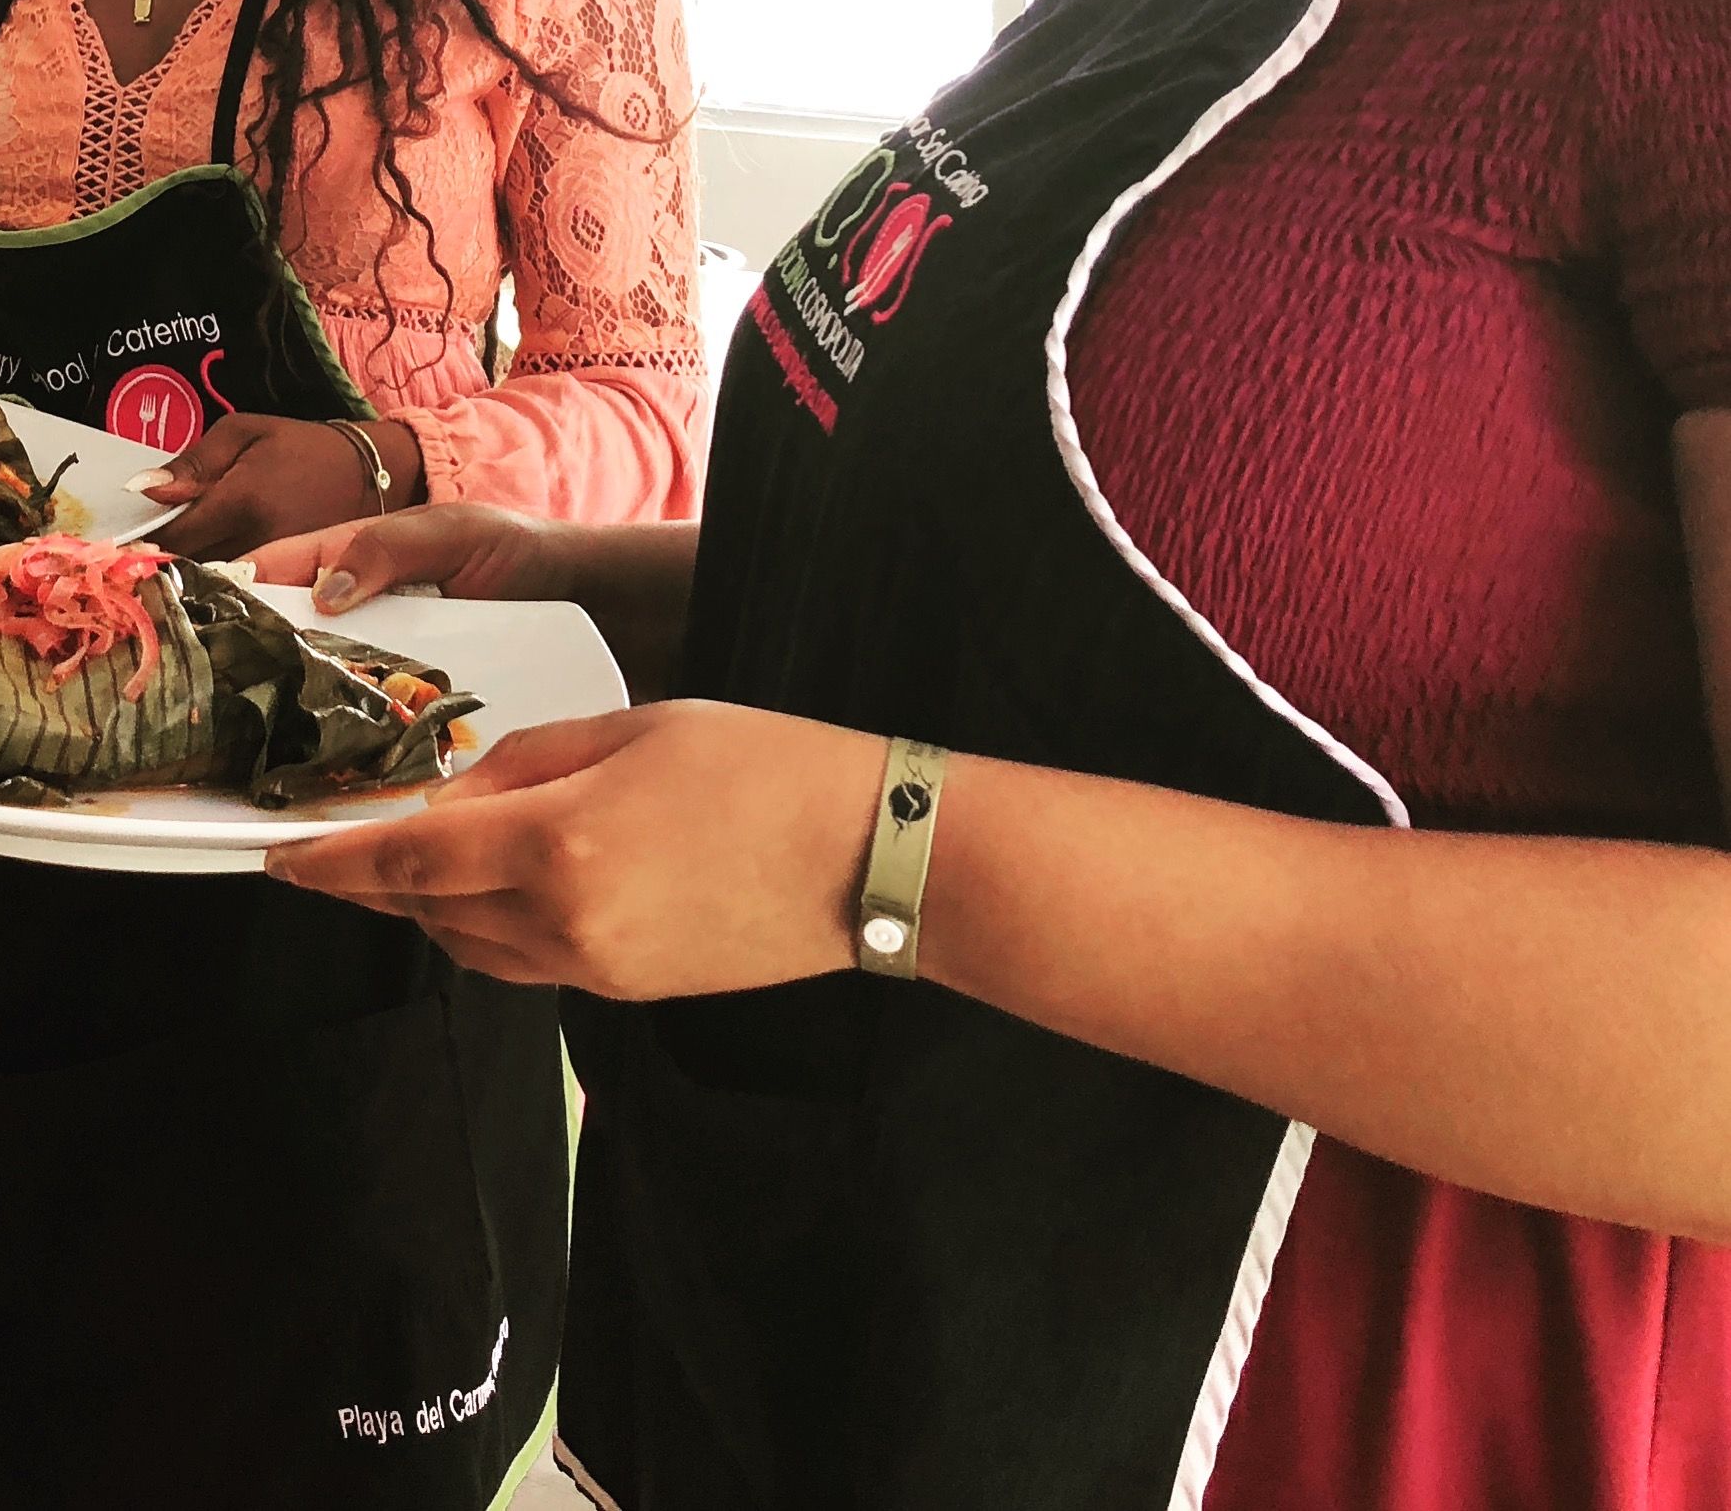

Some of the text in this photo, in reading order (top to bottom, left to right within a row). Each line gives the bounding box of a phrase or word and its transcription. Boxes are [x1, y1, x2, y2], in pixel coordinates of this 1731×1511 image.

[106, 310, 221, 358] Catering
[337, 1404, 405, 1445] Playa
[416, 1395, 446, 1434] del
